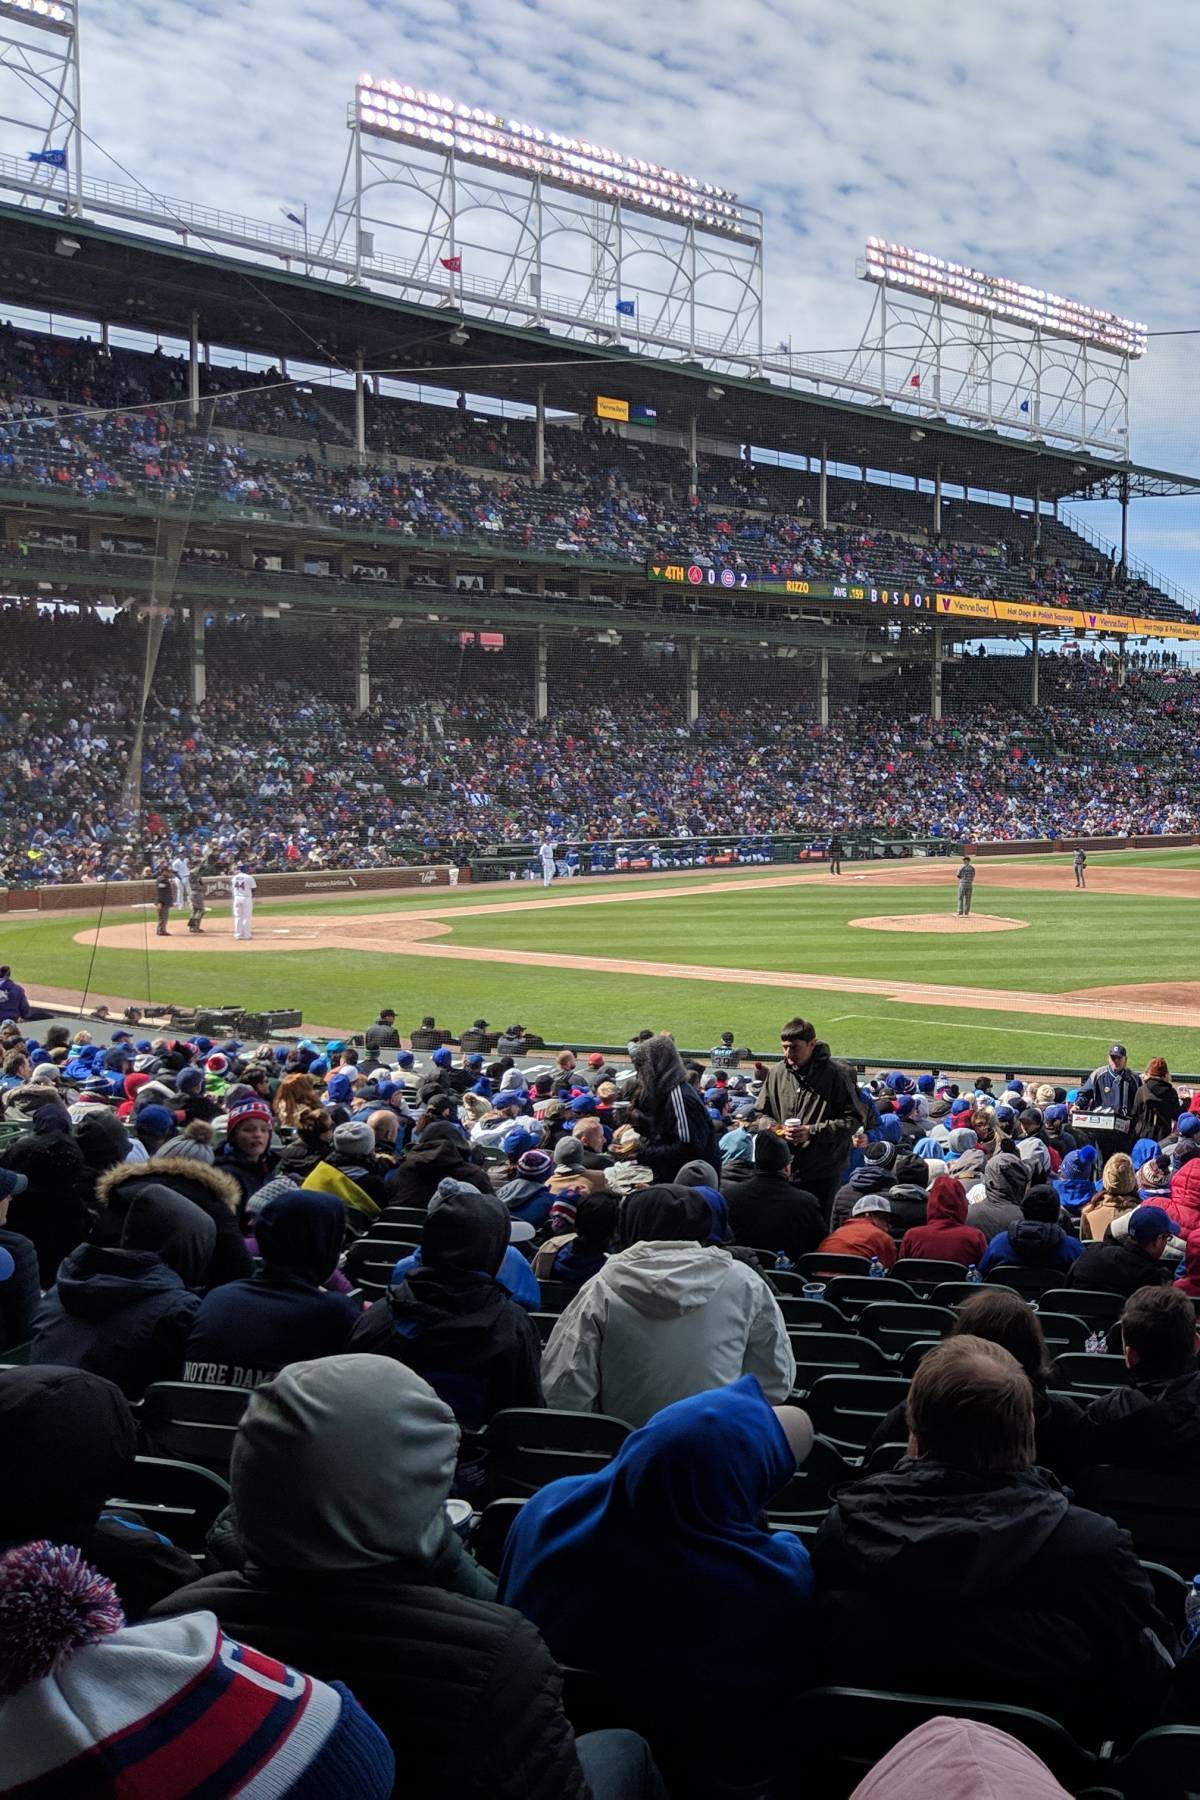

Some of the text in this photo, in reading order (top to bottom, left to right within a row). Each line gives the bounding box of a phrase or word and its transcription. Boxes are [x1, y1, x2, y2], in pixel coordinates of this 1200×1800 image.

[664, 565, 748, 588] 4TH 0 2
[786, 580, 809, 593] RIZZO
[833, 587, 847, 598] AVG
[871, 589, 878, 602] B
[893, 592, 899, 605] S
[234, 881, 245, 891] 44
[183, 1361, 229, 1385] NOTRE
